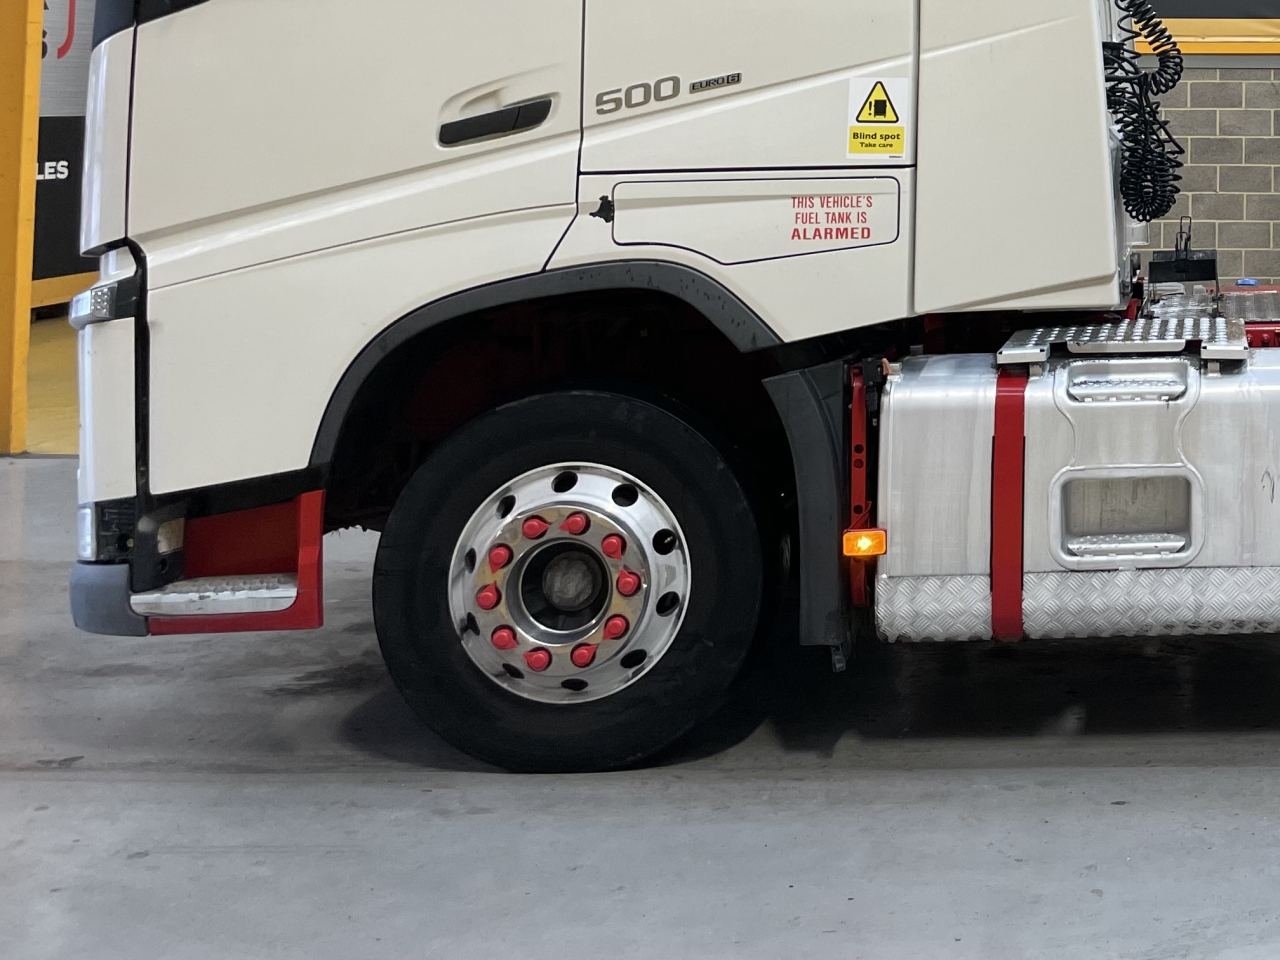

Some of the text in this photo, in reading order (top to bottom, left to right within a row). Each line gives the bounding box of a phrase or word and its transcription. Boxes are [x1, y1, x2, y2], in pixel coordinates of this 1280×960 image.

[595, 75, 681, 115] 500
[692, 77, 725, 91] EURO
[852, 132, 901, 142] Blind spot
[791, 195, 873, 209] THIS VEHICLE'S
[795, 211, 867, 224] FUEL TANK IS
[791, 227, 871, 240] ALARMED
